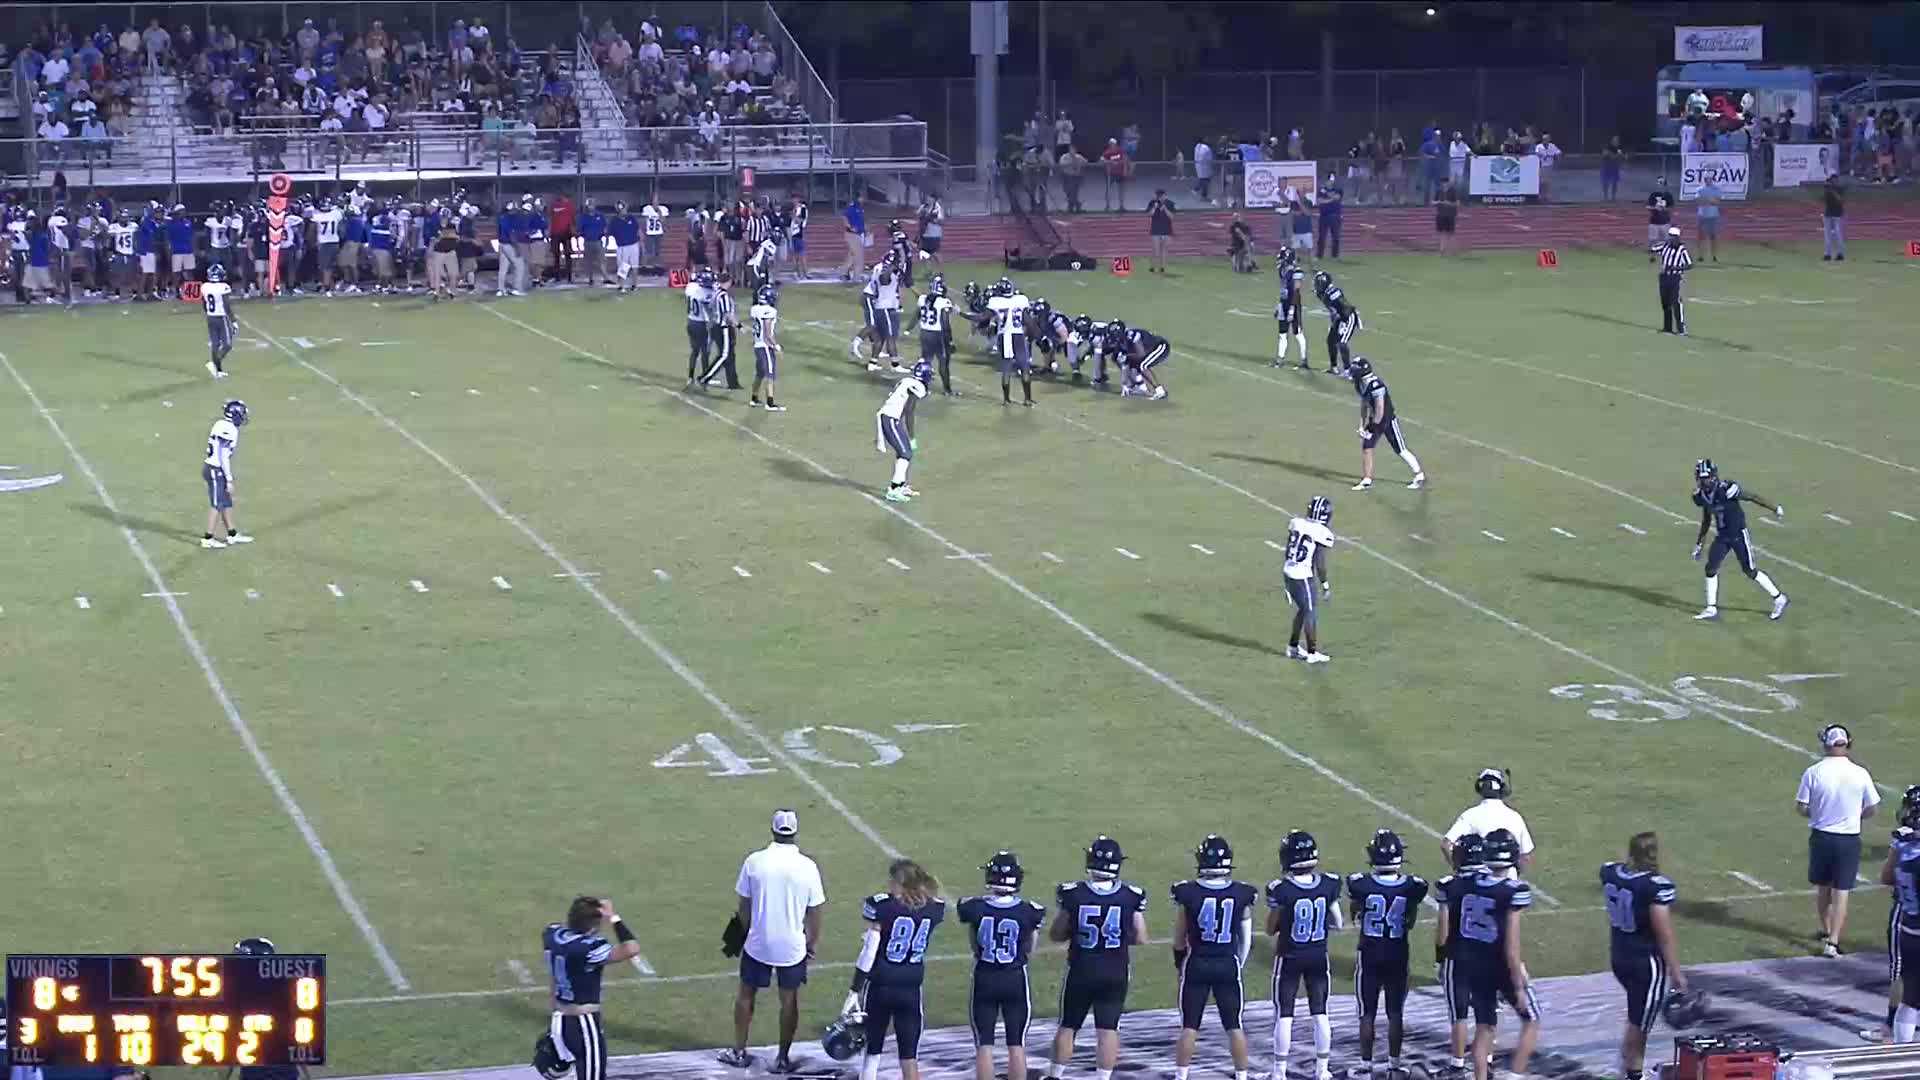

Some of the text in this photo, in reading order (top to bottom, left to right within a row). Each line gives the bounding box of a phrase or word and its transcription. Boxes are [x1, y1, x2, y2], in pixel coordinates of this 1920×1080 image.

[1113, 257, 1130, 271] 20
[650, 723, 904, 776] 40
[886, 915, 932, 964] 84
[976, 915, 1021, 964] 43
[1078, 904, 1122, 949] 54
[1197, 897, 1235, 944] 41
[1290, 896, 1328, 943] 81
[1363, 894, 1408, 938] 24
